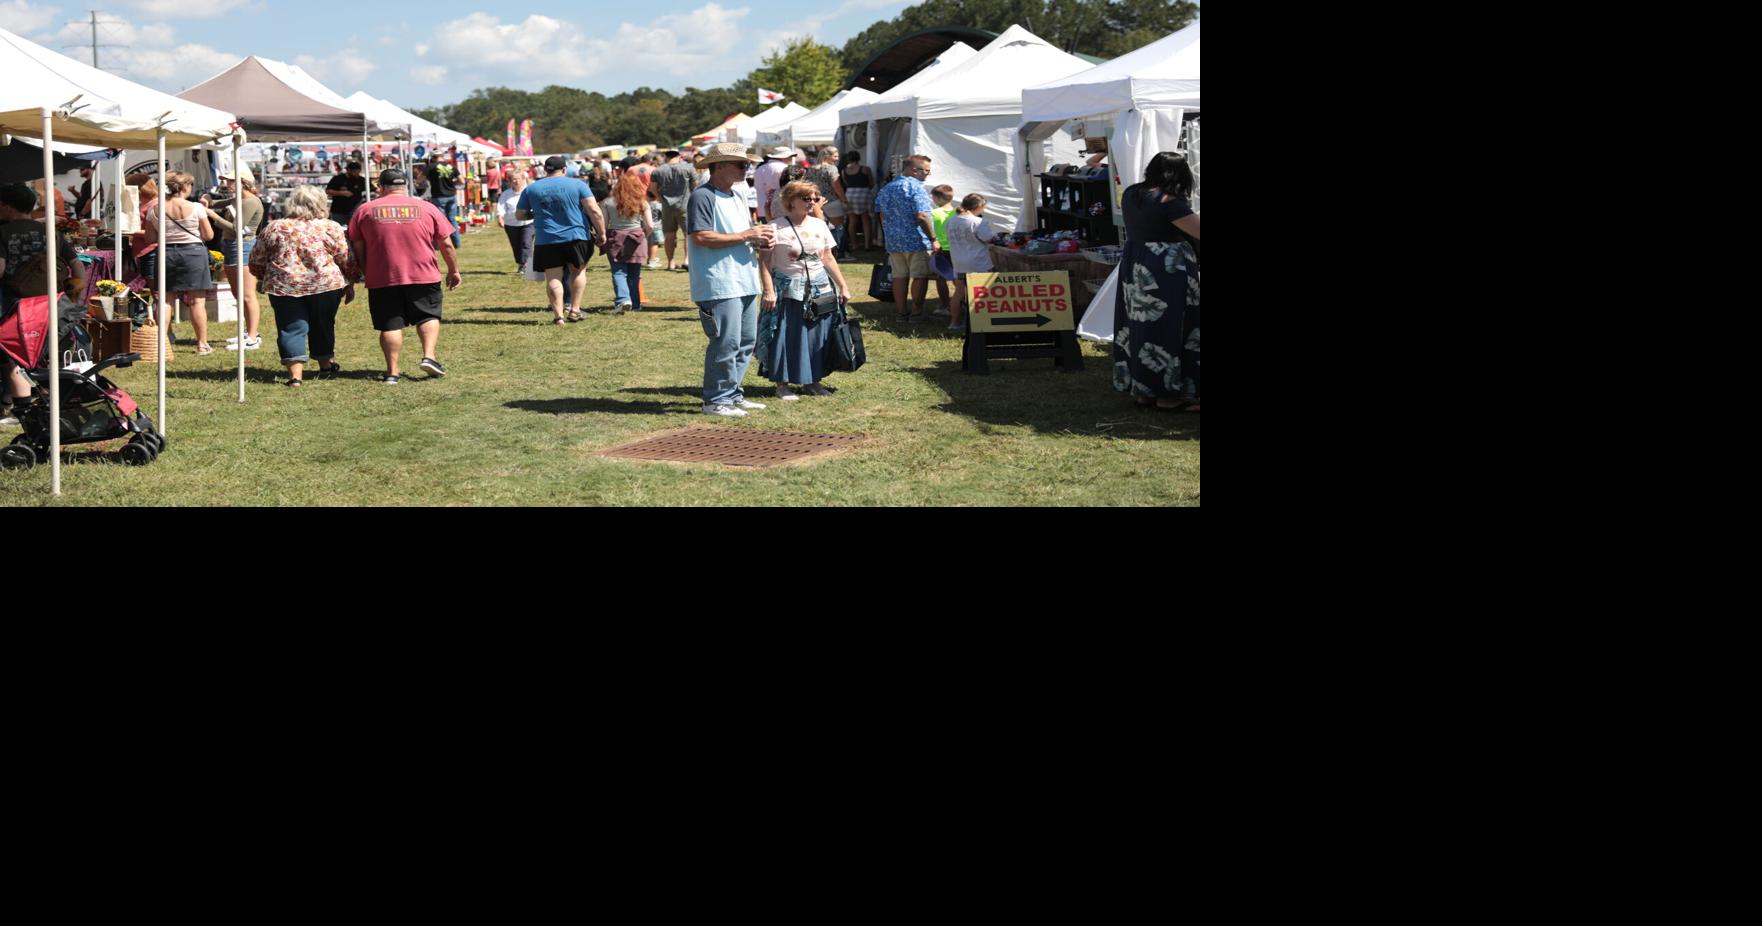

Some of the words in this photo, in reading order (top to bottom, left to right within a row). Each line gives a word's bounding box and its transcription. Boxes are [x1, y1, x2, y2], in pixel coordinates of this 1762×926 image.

[995, 275, 1041, 283] ALBERT'S
[973, 284, 1065, 299] BOILED
[974, 299, 1067, 313] PEANUTS
